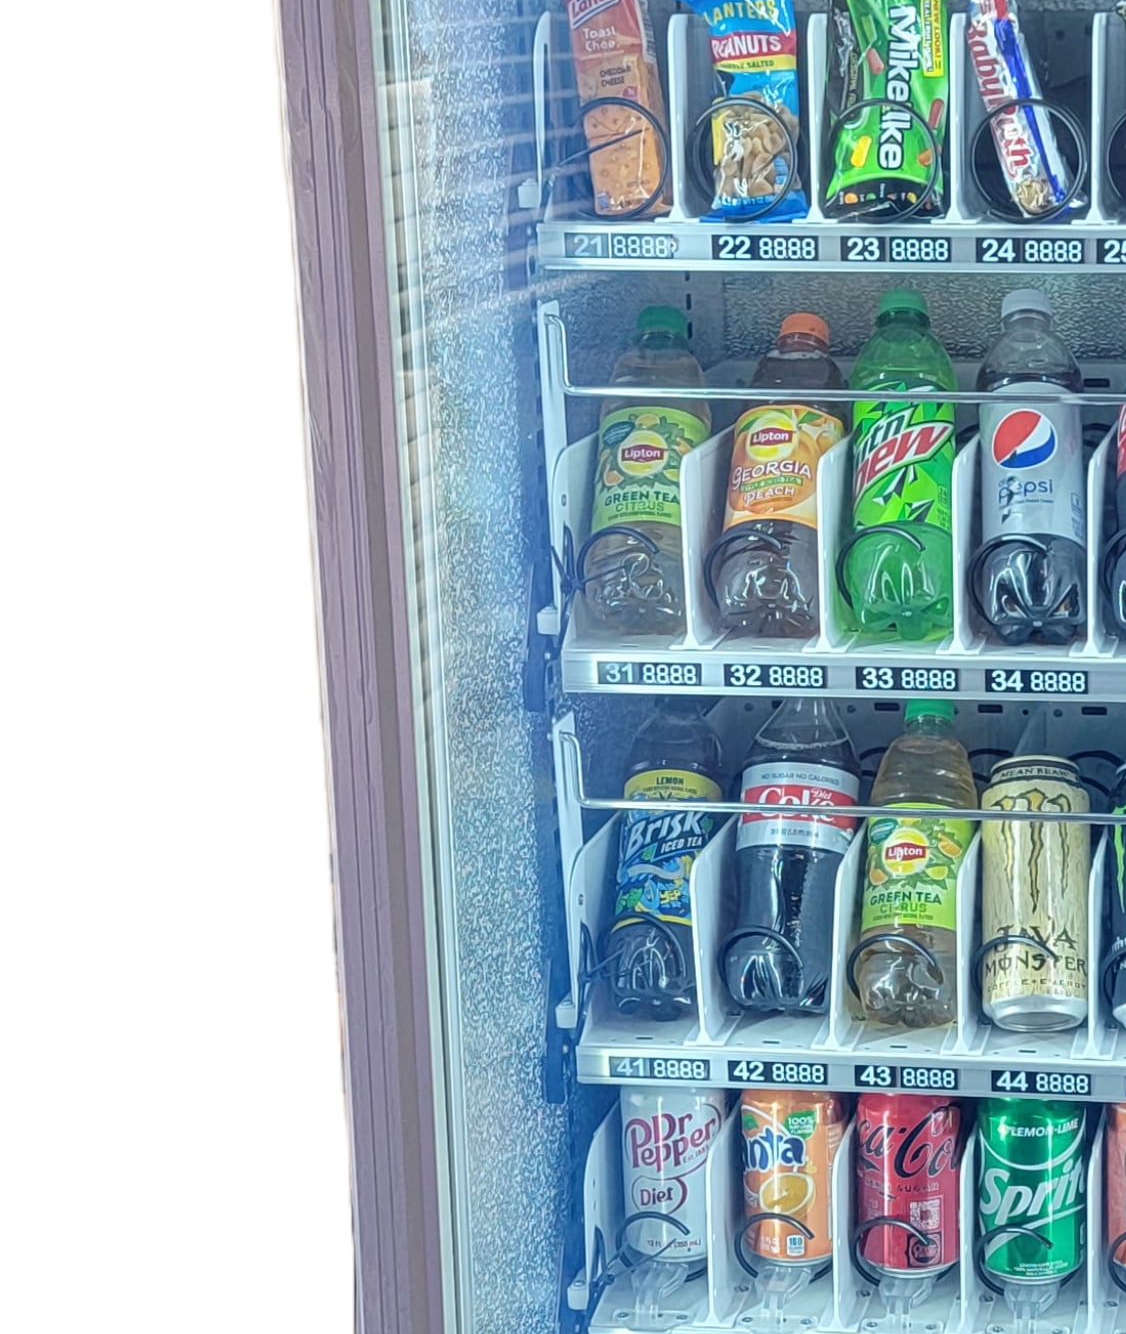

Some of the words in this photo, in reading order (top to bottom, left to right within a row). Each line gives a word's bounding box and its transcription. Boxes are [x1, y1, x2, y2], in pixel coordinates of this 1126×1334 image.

[582, 26, 616, 40] Toast
[711, 34, 783, 60] PEANUTS
[886, 6, 918, 102] Mike
[746, 59, 775, 69] SALTED
[967, 23, 1006, 98] Baby
[601, 76, 625, 87] CHEESE
[878, 111, 912, 169] Ike
[574, 236, 601, 256] 21
[719, 237, 751, 259] 22
[847, 238, 880, 259] 23
[982, 239, 1015, 261] 24
[752, 432, 789, 444] Lipton
[624, 448, 661, 460] Lipton
[731, 460, 812, 490] GEORGIA
[604, 490, 650, 507] GREEN
[653, 491, 680, 505] TEA
[743, 486, 796, 506] PEACH
[615, 501, 665, 513] CITRUS
[606, 664, 632, 683] 31
[731, 666, 761, 685] 32
[862, 668, 893, 688] 33
[992, 671, 1023, 691] 34
[656, 776, 684, 785] LEMON
[758, 787, 835, 822] Coke
[661, 839, 685, 853] ICED
[888, 847, 923, 861] Lipton
[870, 890, 912, 906] GREEN
[915, 891, 942, 905] TEA
[880, 903, 927, 914] CIRUS
[985, 950, 1088, 977] MONSTER
[618, 1057, 643, 1074] 41
[734, 1062, 764, 1081] 42
[860, 1066, 891, 1086] 43
[997, 1072, 1027, 1091] 44
[650, 1113, 693, 1145] Dr
[787, 1117, 814, 1126] 100%
[626, 1117, 716, 1174] Pepper
[744, 1126, 806, 1172] nta
[639, 1187, 674, 1207] Diet
